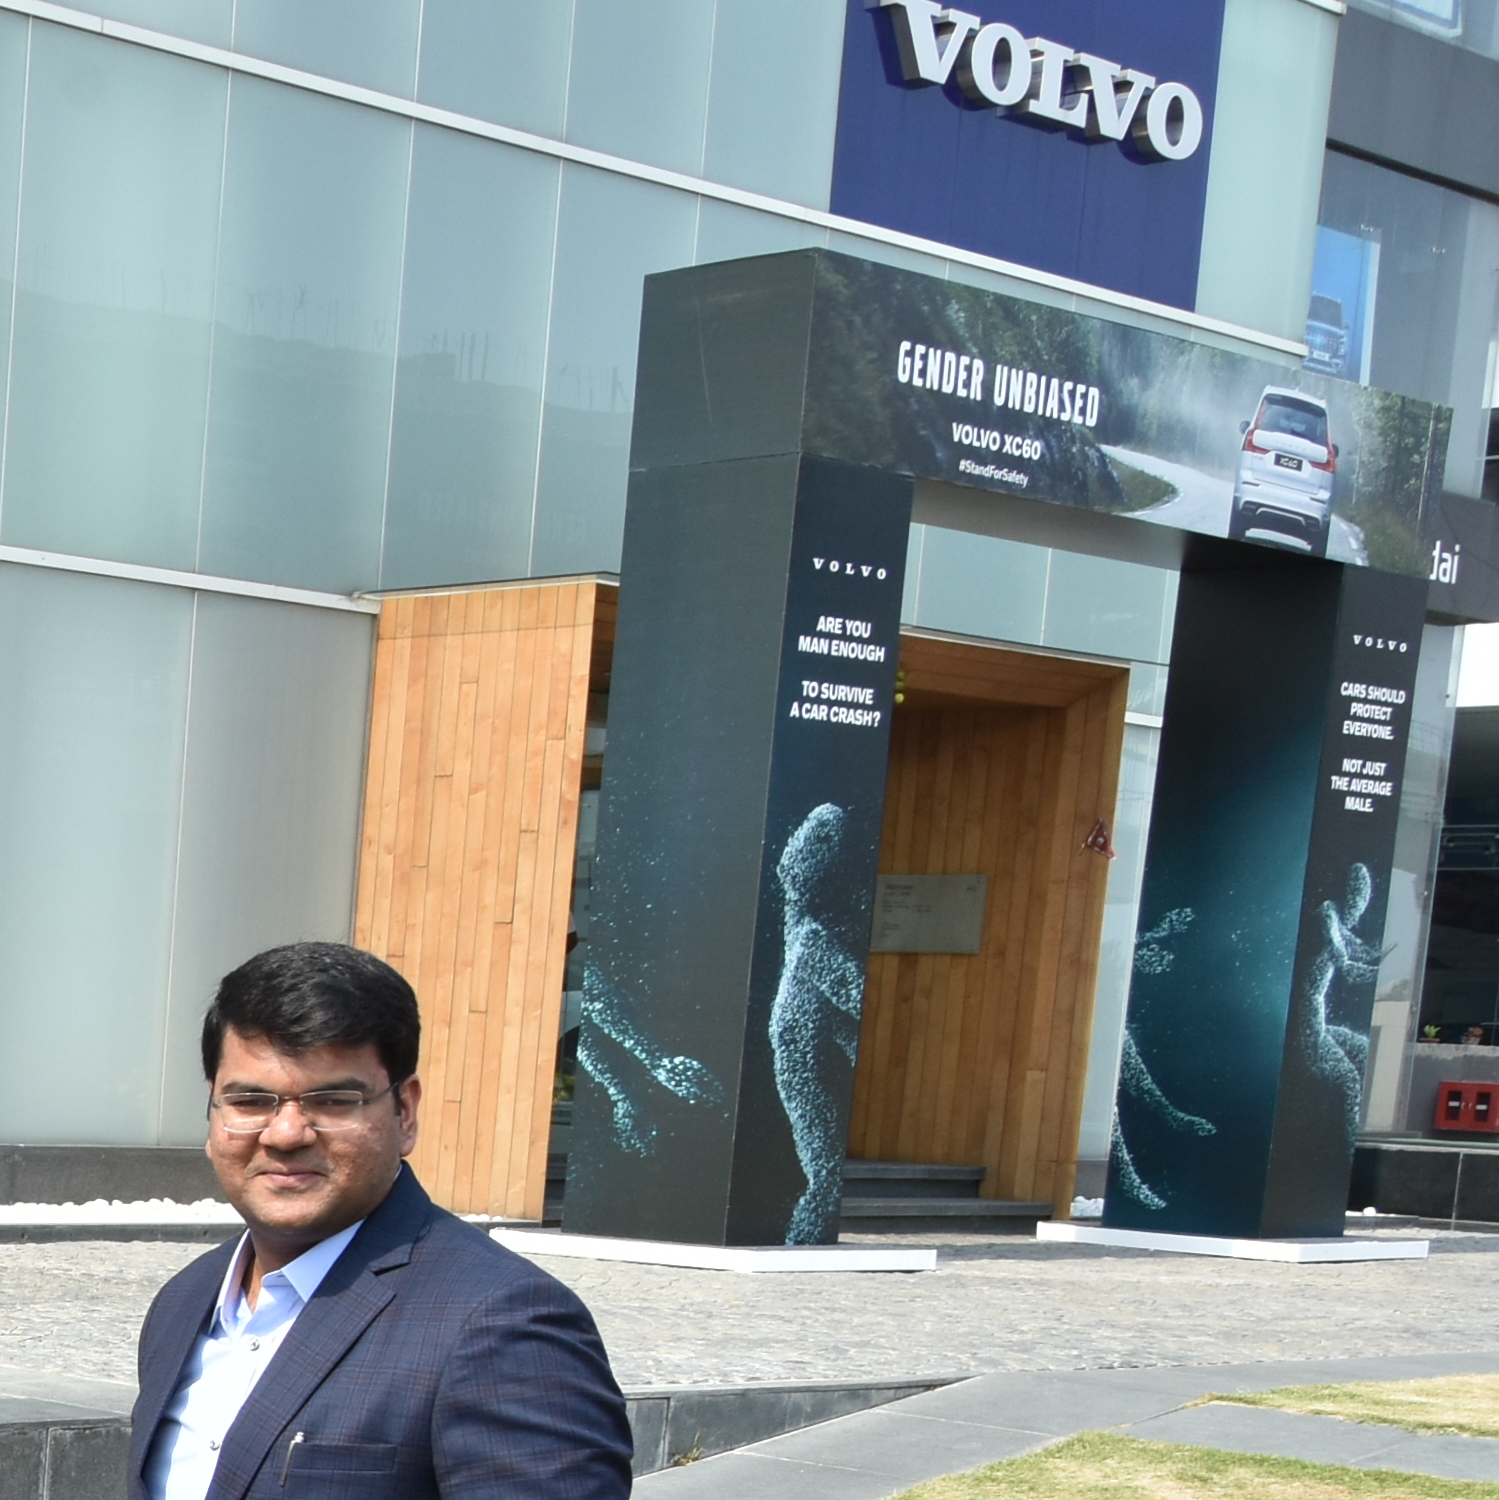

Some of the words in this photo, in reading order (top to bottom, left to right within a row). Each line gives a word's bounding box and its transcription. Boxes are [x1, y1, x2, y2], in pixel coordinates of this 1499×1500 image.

[878, 0, 1203, 161] VOLVO
[897, 340, 984, 401] GENDER
[993, 363, 1100, 428] UNBIASED
[952, 422, 1000, 452] VOLVO
[1003, 434, 1042, 461] XC60
[958, 459, 1029, 489] #StandForSafety
[812, 557, 887, 580] VOLVO
[816, 615, 843, 635] ARE
[845, 619, 872, 639] YOU
[798, 635, 829, 655] MAN
[831, 640, 885, 662] ENOUGH
[1352, 635, 1407, 653] VOLVO
[801, 680, 819, 698] TO
[821, 683, 874, 705] SURVIVE
[1340, 682, 1366, 699] CARS
[1367, 685, 1406, 704] SHOULD
[789, 701, 800, 718] A
[801, 703, 828, 722] CAR
[829, 707, 881, 728] CRASH?
[1350, 702, 1393, 721] PROTECT
[1342, 720, 1394, 740] EVERYONE.
[1341, 758, 1362, 774] NOT
[1362, 761, 1387, 777] JUST
[1330, 775, 1349, 791] THE
[1349, 778, 1394, 796] AVERAGE
[1344, 796, 1374, 813] MALE.
